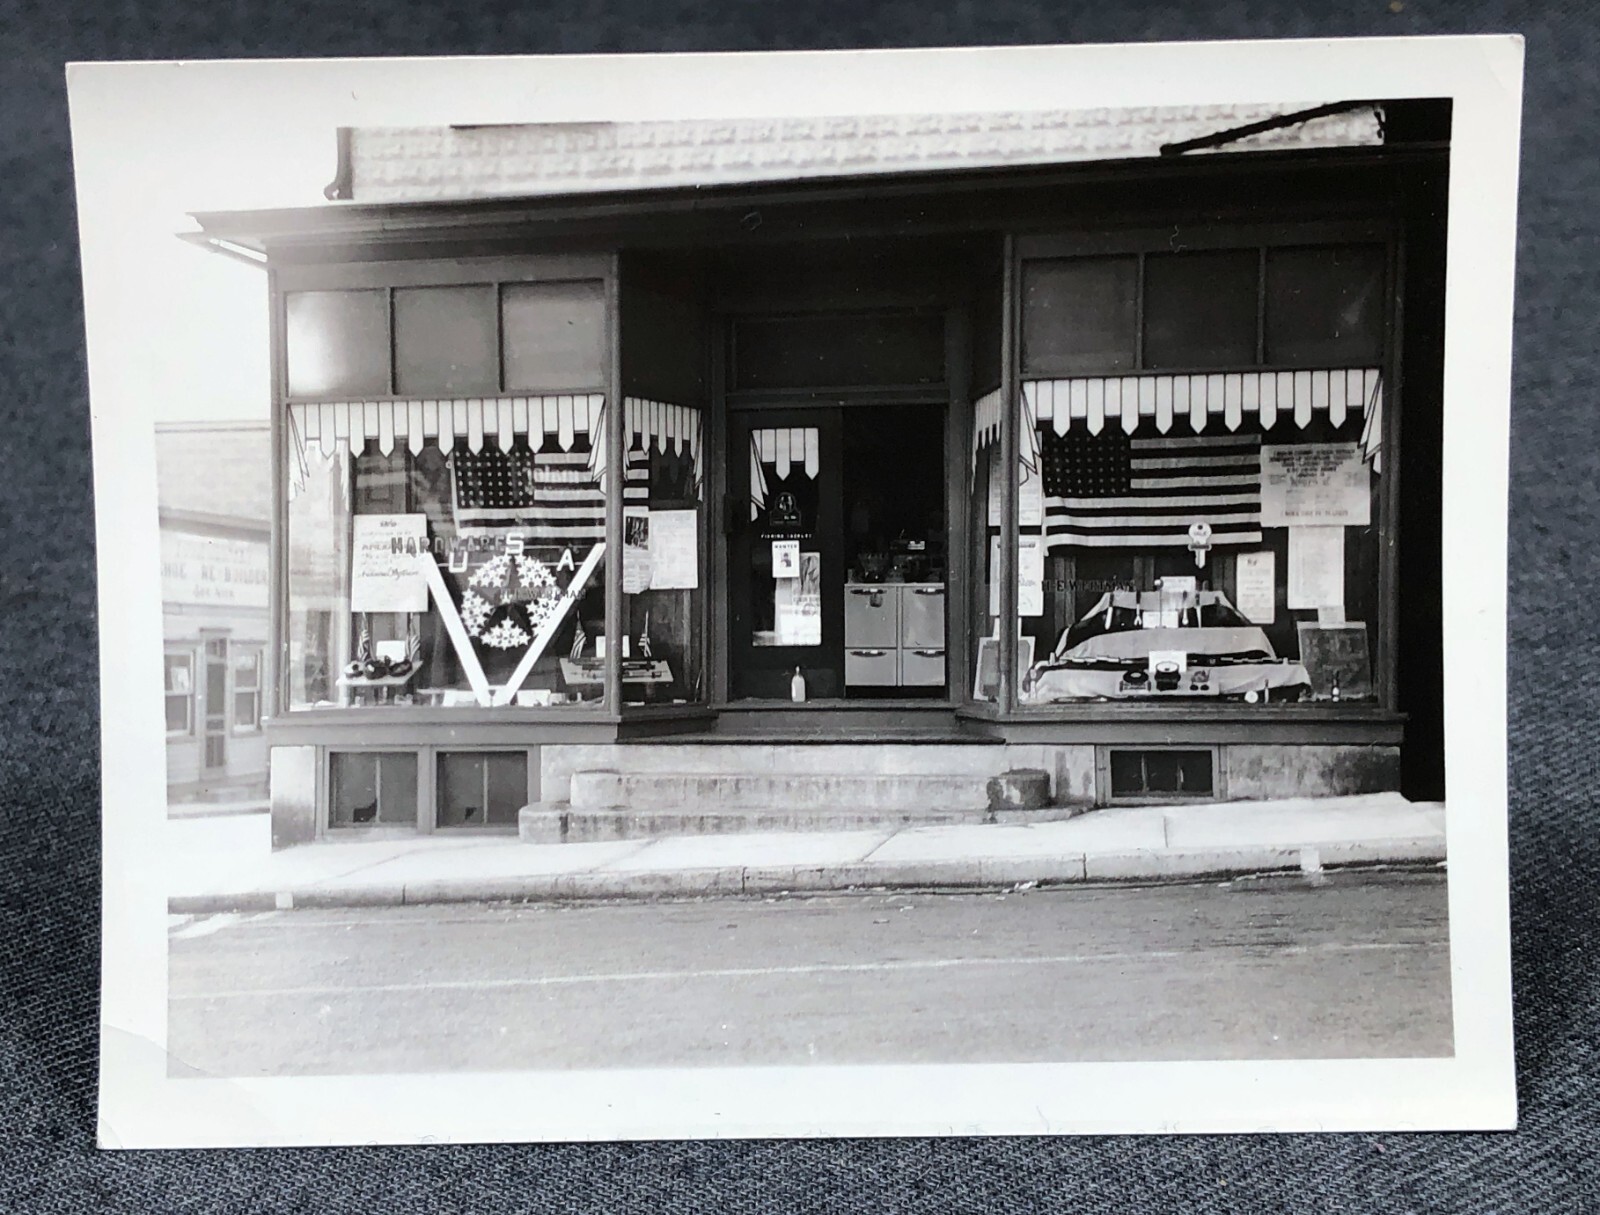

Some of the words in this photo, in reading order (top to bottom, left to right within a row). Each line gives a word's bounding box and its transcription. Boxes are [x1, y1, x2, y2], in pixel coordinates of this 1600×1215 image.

[391, 535, 506, 556] HARDWARE
[506, 532, 524, 556] S
[556, 548, 575, 572] A
